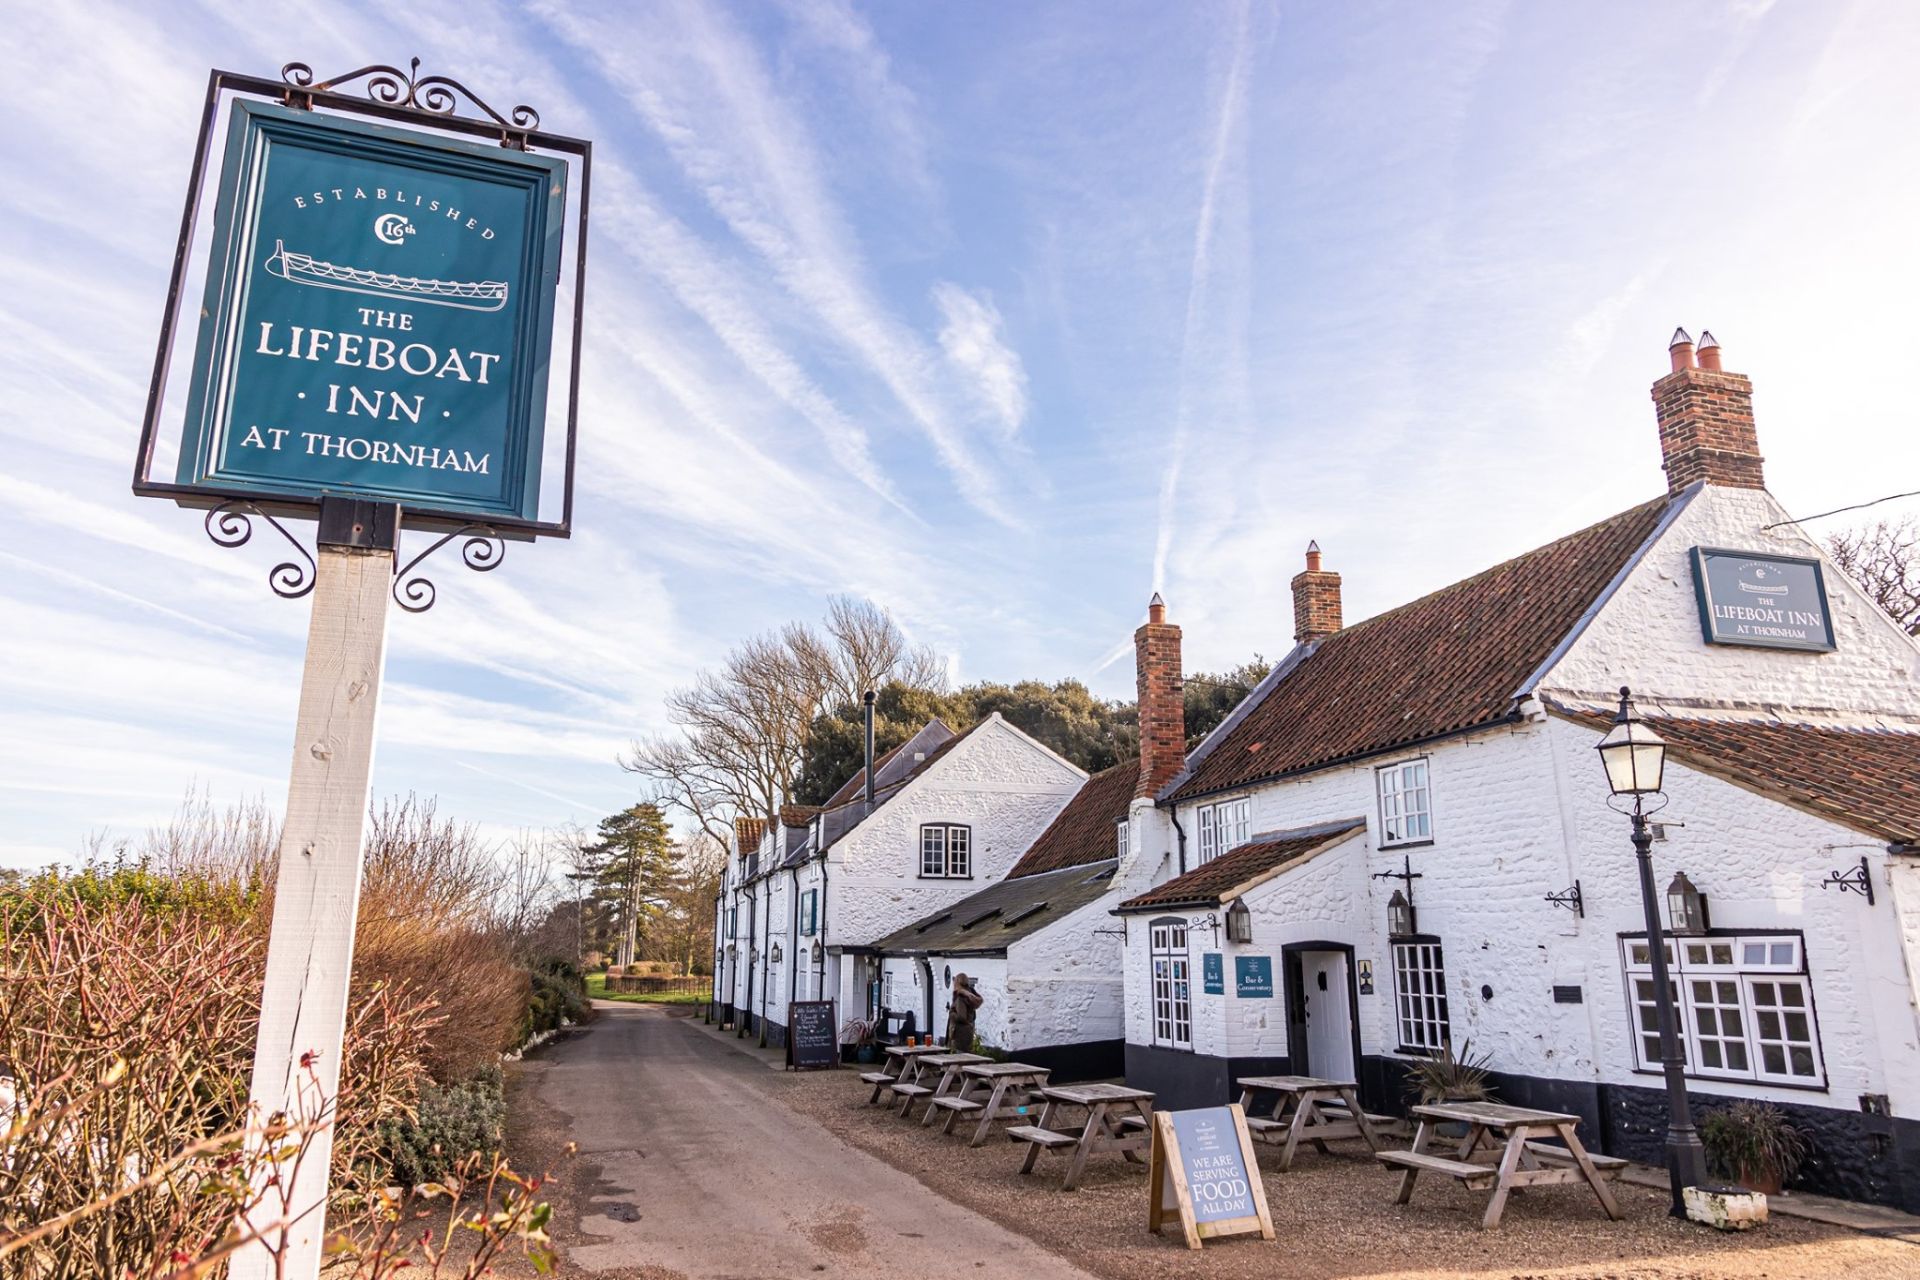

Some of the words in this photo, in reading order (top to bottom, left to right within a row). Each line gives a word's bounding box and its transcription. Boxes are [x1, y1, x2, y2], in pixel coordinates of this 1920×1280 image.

[295, 187, 495, 241] ESTABLISHED
[358, 308, 414, 331] THE
[256, 322, 500, 384] LIFEBOAT
[325, 384, 425, 424] INN
[240, 426, 289, 450] AT
[301, 432, 490, 474] THORNHAM
[1758, 598, 1775, 606] THE
[1714, 605, 1784, 623] LIFEBOAT
[1788, 611, 1820, 626] INN
[1737, 624, 1750, 634] AT
[1752, 626, 1805, 638] THORNHAM
[1193, 1158, 1210, 1168] WE
[1212, 1155, 1233, 1166] ARE
[1193, 1167, 1238, 1181] SERVING
[1192, 1180, 1246, 1201] FOOD
[1203, 1202, 1223, 1214] ALL
[1224, 1200, 1245, 1211] DAY
